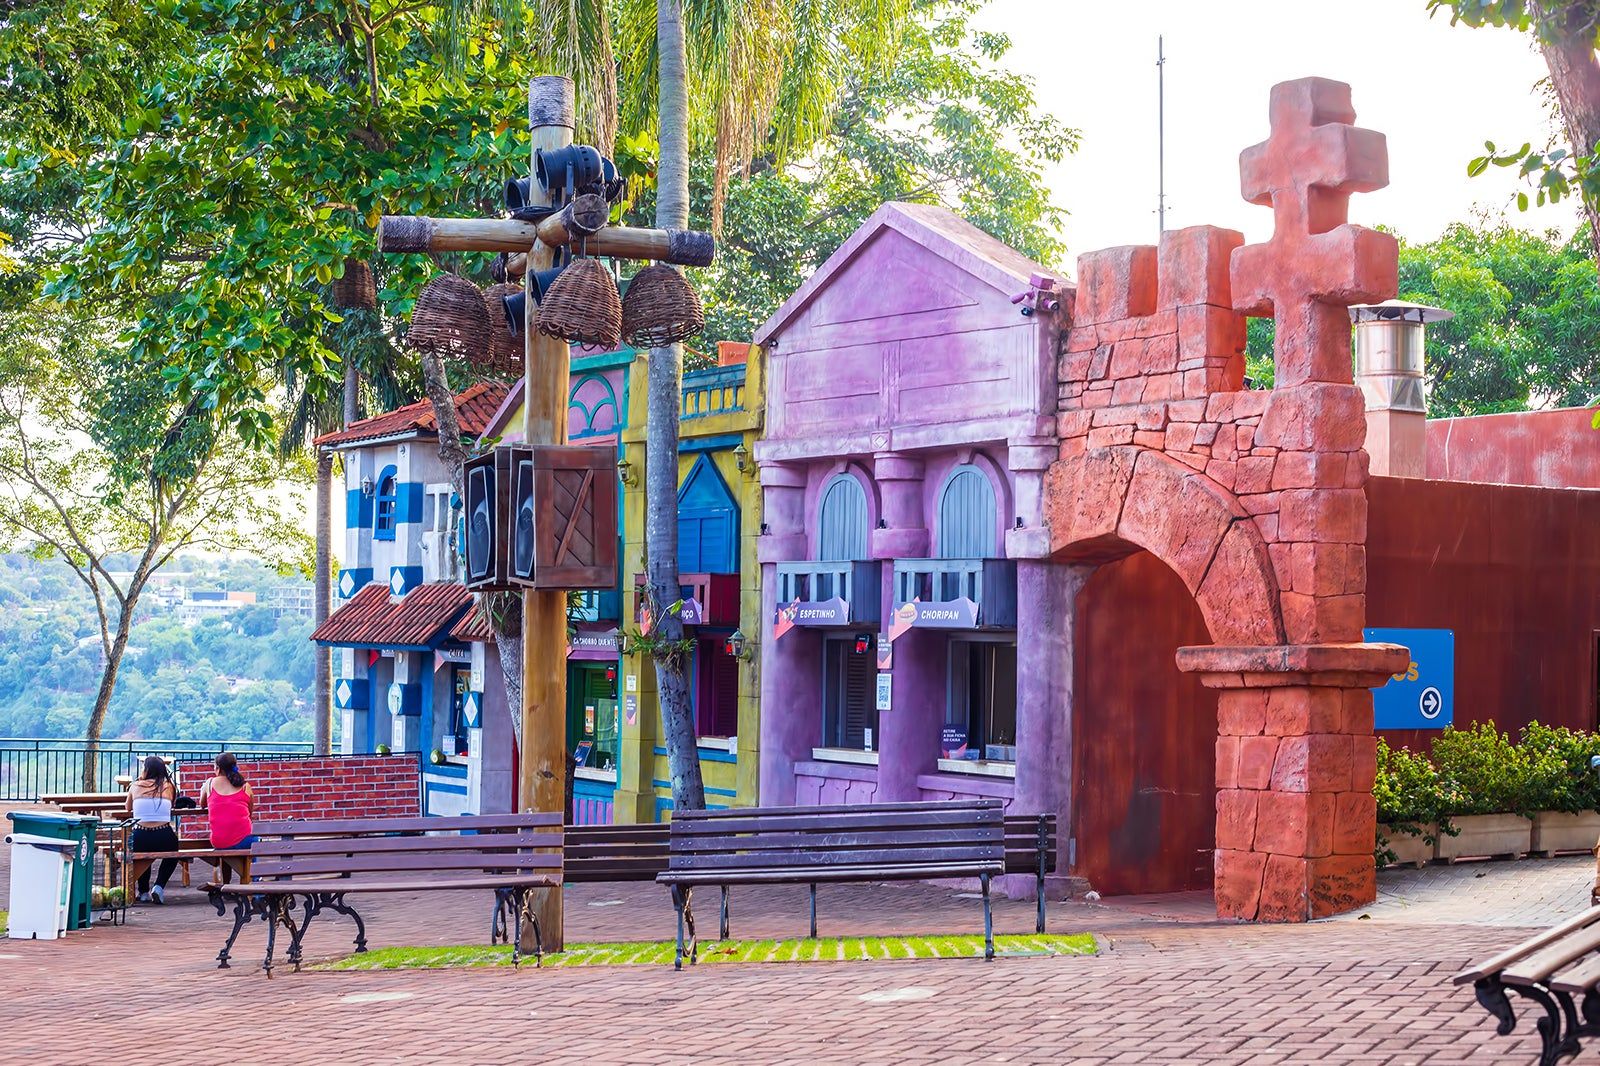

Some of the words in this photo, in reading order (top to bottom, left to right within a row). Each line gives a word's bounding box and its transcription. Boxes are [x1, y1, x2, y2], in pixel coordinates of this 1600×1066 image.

[799, 609, 836, 619] ESPETINHO
[921, 610, 960, 620] CHORIPAN
[598, 638, 616, 647] QUENTE
